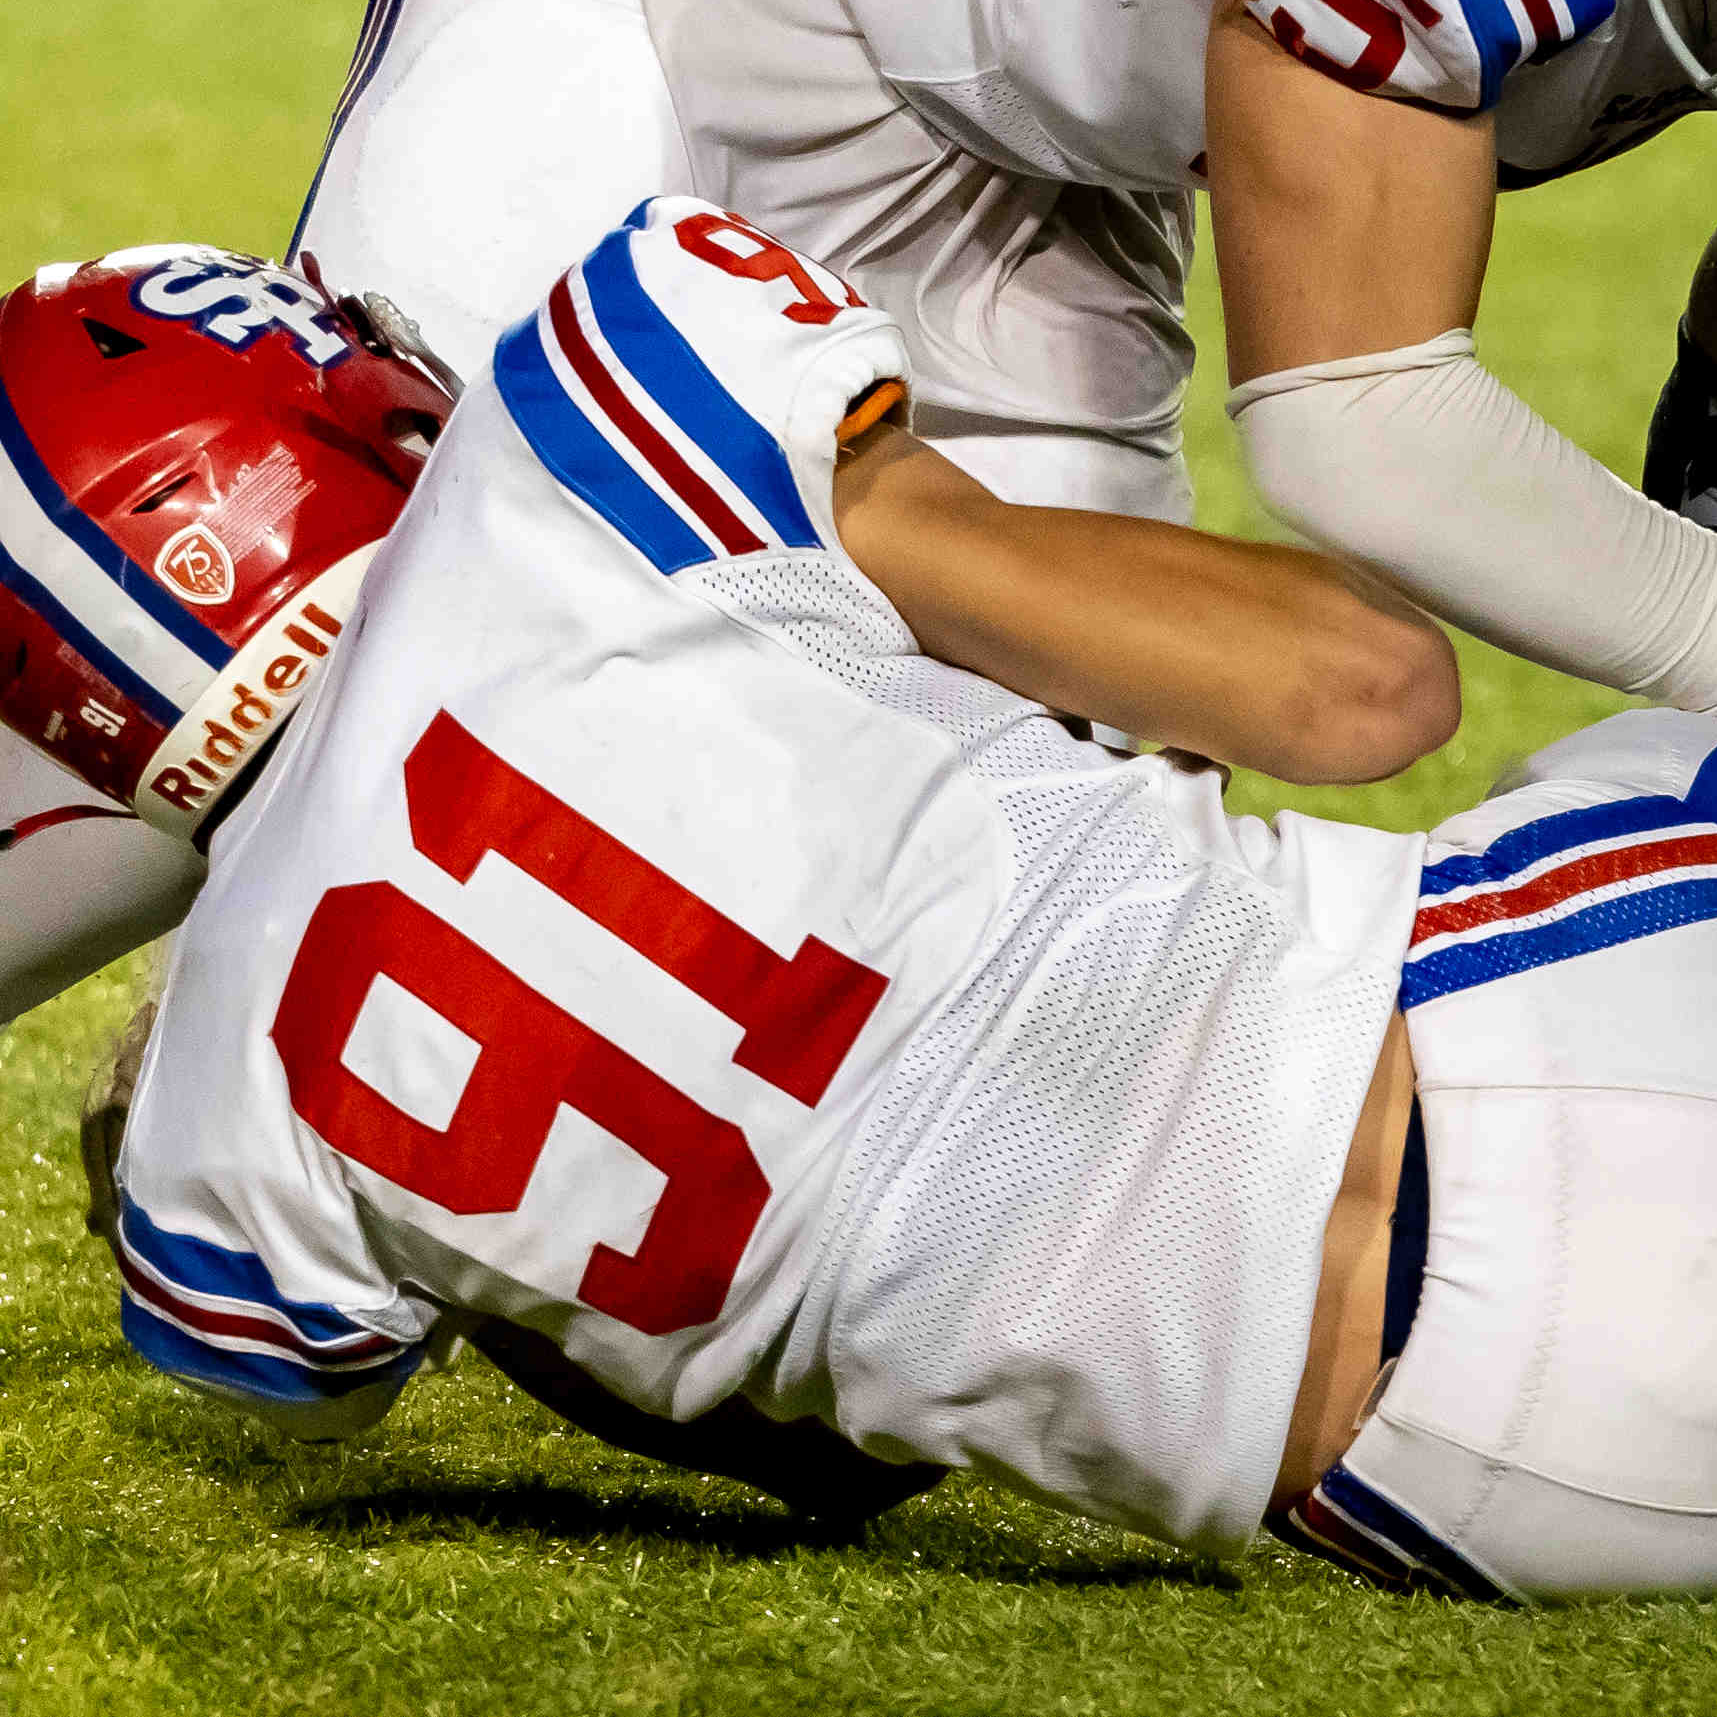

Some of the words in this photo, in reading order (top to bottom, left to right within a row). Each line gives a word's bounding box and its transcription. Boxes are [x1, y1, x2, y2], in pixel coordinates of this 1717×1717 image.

[169, 537, 212, 584] 75
[79, 697, 127, 738] 91
[149, 601, 344, 812] Riddell
[270, 707, 890, 1337] 91
